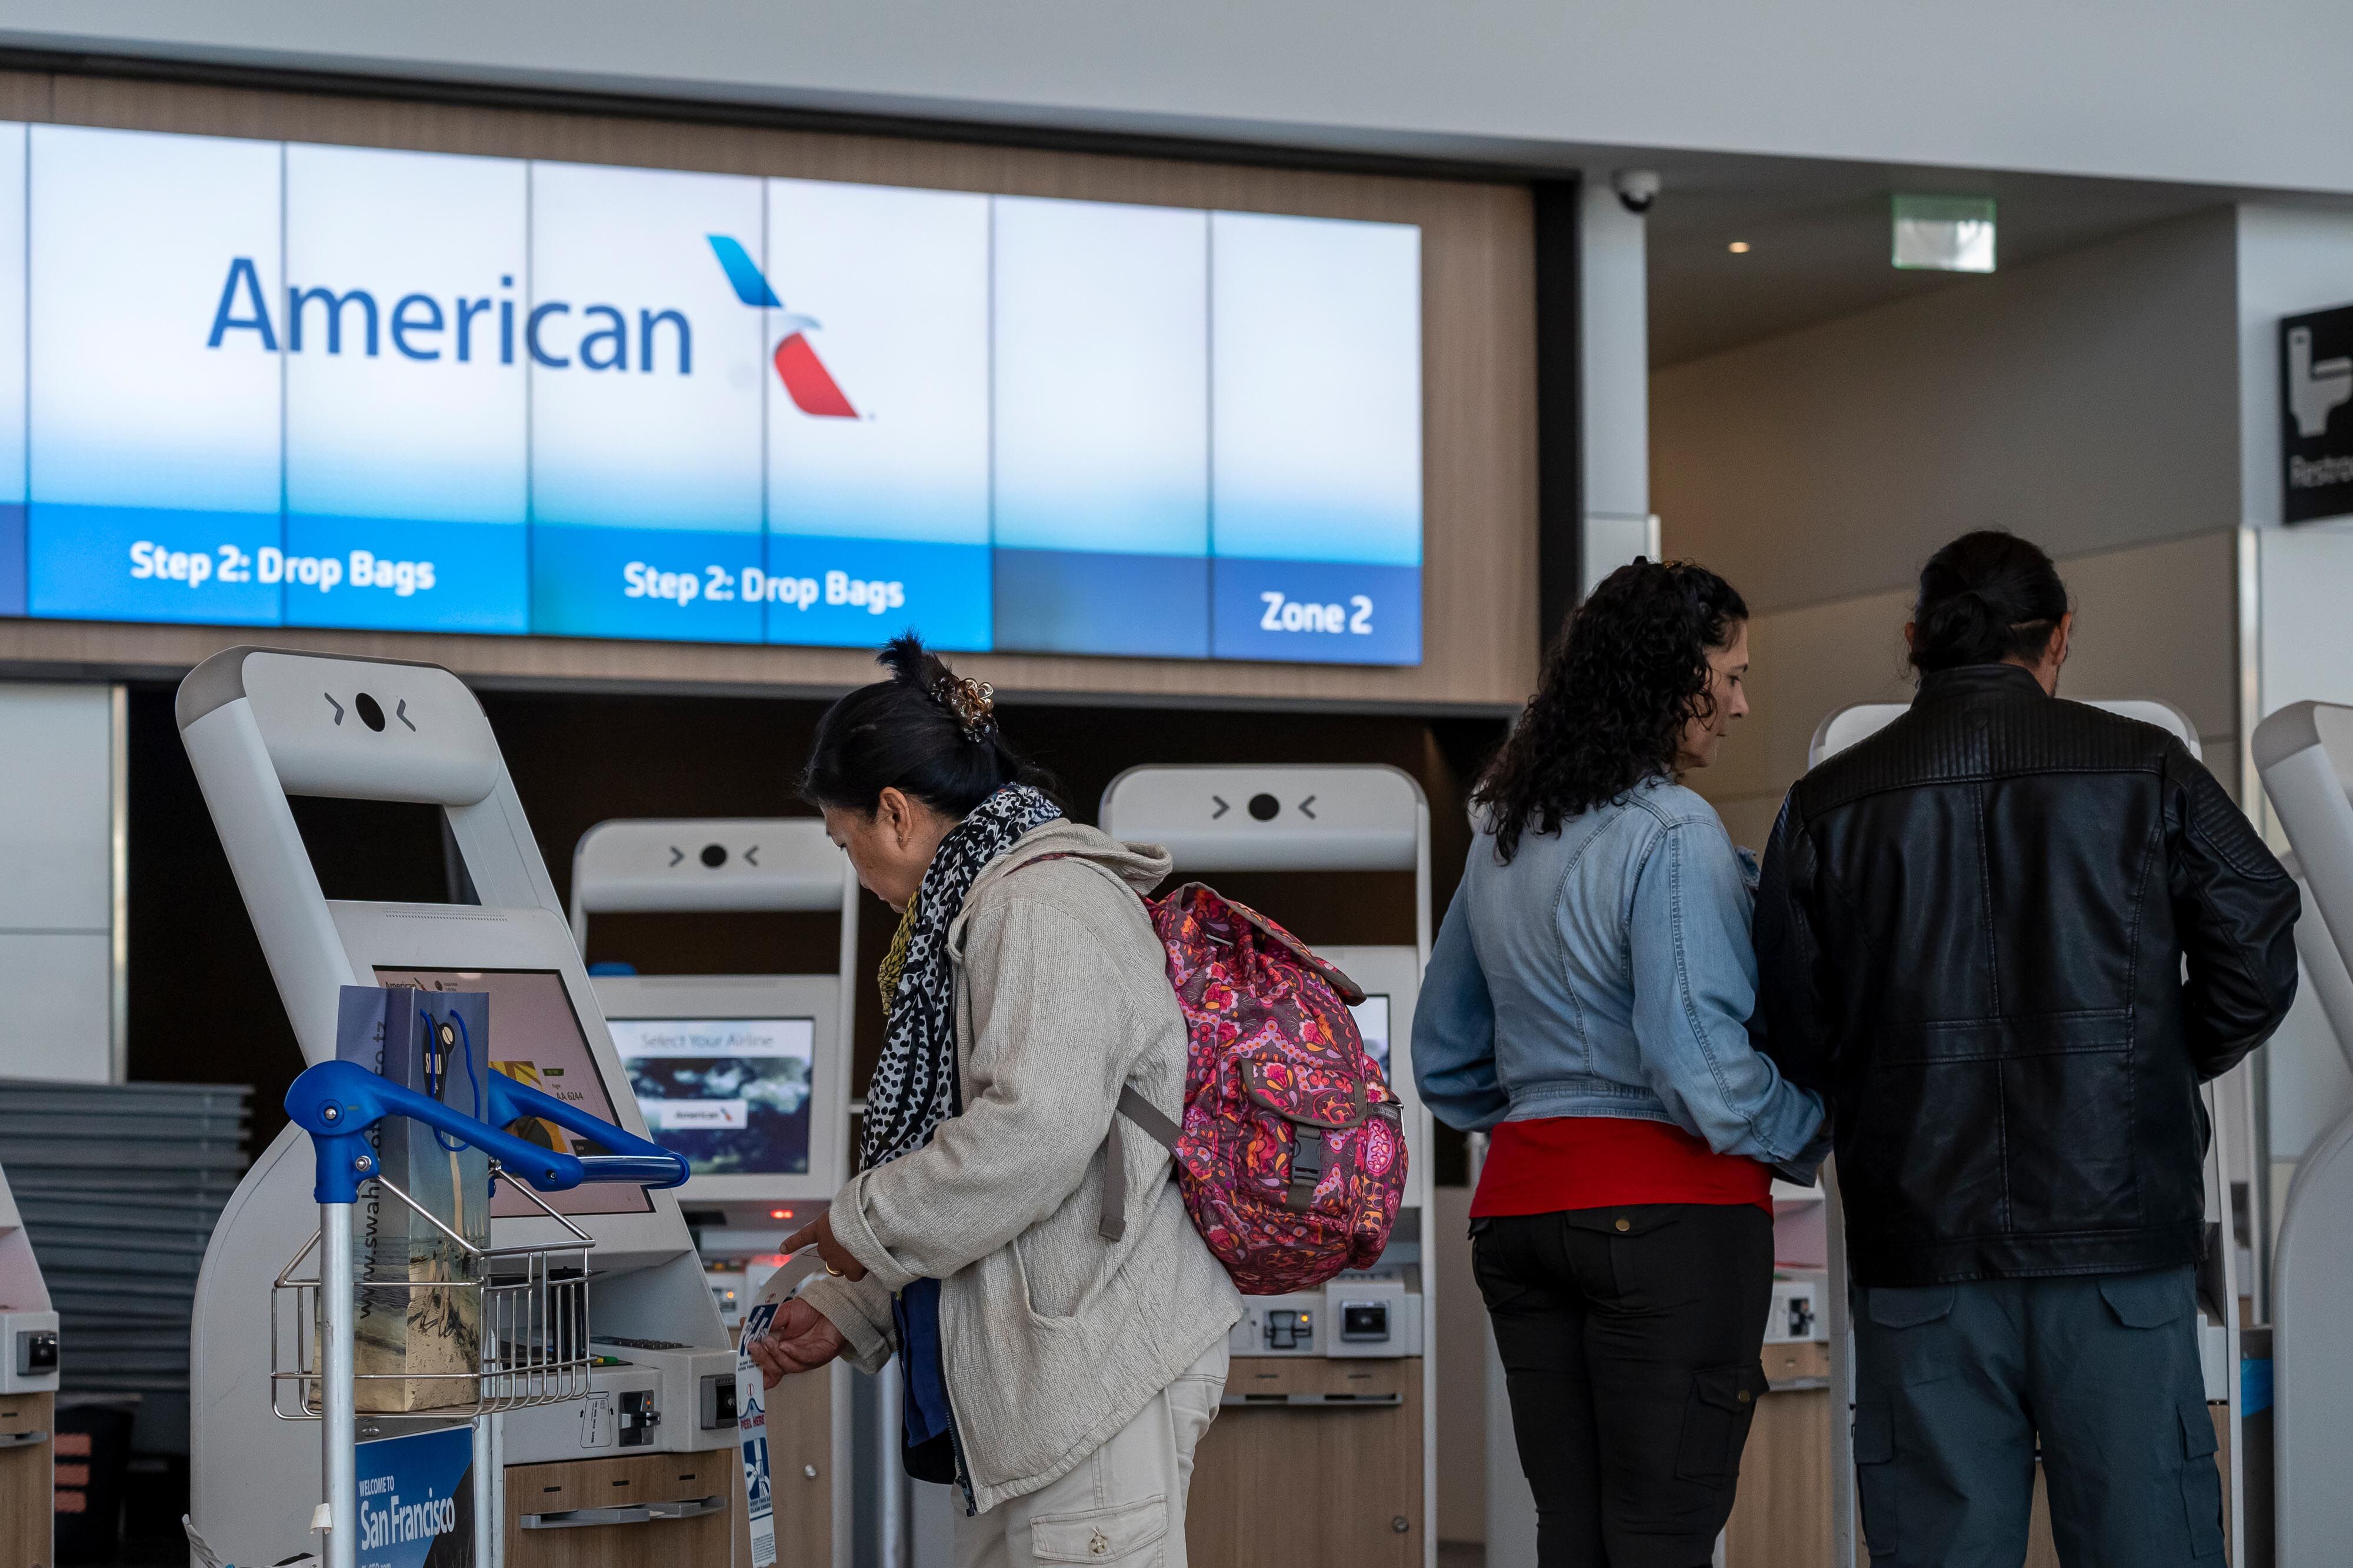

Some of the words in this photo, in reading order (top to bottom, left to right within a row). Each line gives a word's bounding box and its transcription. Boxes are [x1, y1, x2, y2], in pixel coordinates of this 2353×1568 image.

[206, 256, 692, 375] American
[129, 541, 212, 588] Step
[216, 545, 251, 582] 2:
[257, 546, 343, 593] Drop
[349, 550, 436, 597] Bags
[623, 561, 700, 607] Step
[704, 564, 735, 602] 2:
[741, 566, 819, 612] Drop
[825, 569, 906, 615] Bags
[1259, 590, 1346, 634] Zone
[1349, 595, 1374, 635] 2
[641, 1033, 685, 1049] Select
[688, 1034, 722, 1049] Your
[725, 1033, 774, 1049] Airline
[556, 1092, 567, 1100] AA
[567, 1092, 584, 1100] 6244
[740, 1417, 752, 1430] PEEL
[753, 1414, 765, 1427] HERE
[359, 1477, 386, 1497] WELCOME
[387, 1475, 395, 1492] TO
[361, 1500, 389, 1550] San
[391, 1487, 455, 1544] Francisco
[750, 1506, 760, 1514] CLAIM
